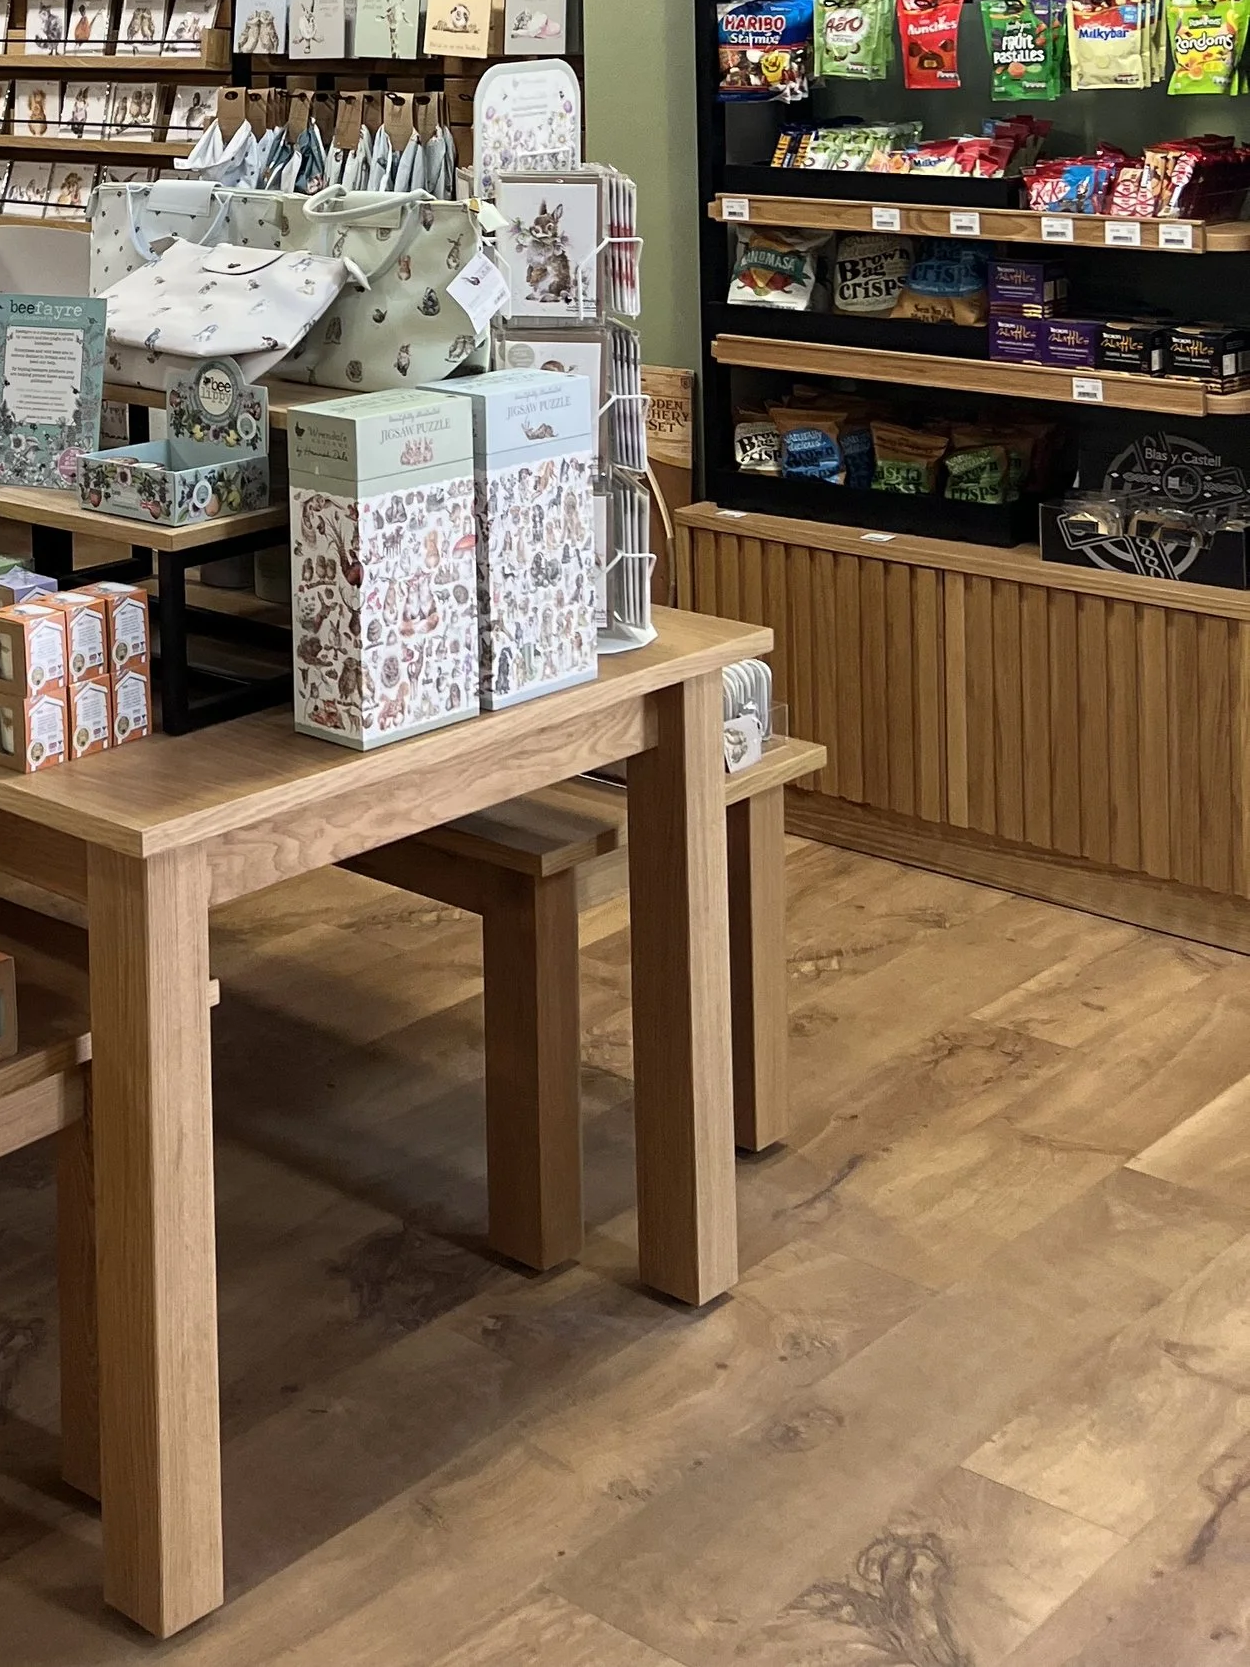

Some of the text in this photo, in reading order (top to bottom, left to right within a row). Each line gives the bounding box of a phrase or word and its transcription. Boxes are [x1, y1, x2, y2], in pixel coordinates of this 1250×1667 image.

[723, 14, 786, 33] HARIBO
[1078, 28, 1130, 40] Milkybar
[10, 299, 84, 320] beefayre
[211, 376, 231, 393] bee
[506, 396, 572, 420] JIGSAW PUZZLE
[647, 408, 689, 428] HERY
[648, 419, 676, 433] SET
[380, 418, 451, 445] JIGSAW PUZZLE
[1145, 448, 1222, 467] Blas y Castell
